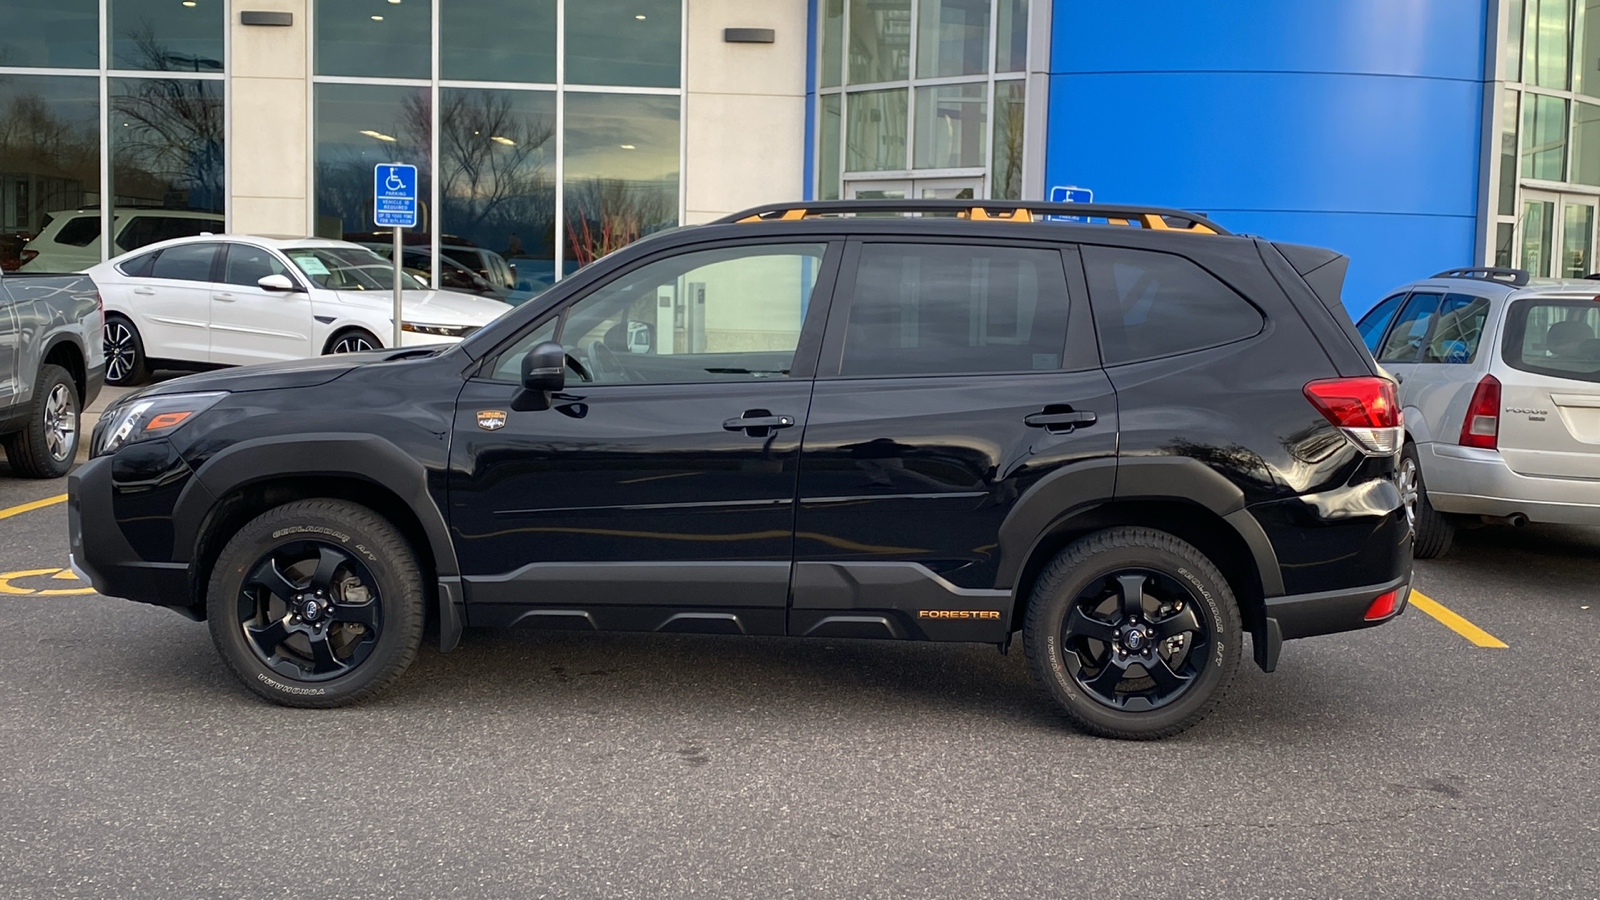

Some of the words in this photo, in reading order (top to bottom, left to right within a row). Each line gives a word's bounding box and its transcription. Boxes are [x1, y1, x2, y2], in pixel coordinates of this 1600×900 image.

[1506, 407, 1548, 415] FOCUS
[272, 526, 350, 543] GEOLANDAR
[355, 544, 376, 561] A/T
[919, 610, 1000, 619] FORESTER
[1178, 567, 1223, 633] GEOLANDAR
[1215, 641, 1224, 667] A/T
[1047, 636, 1076, 701] YOKOHAMA
[257, 673, 326, 695] YOKOHAMA
